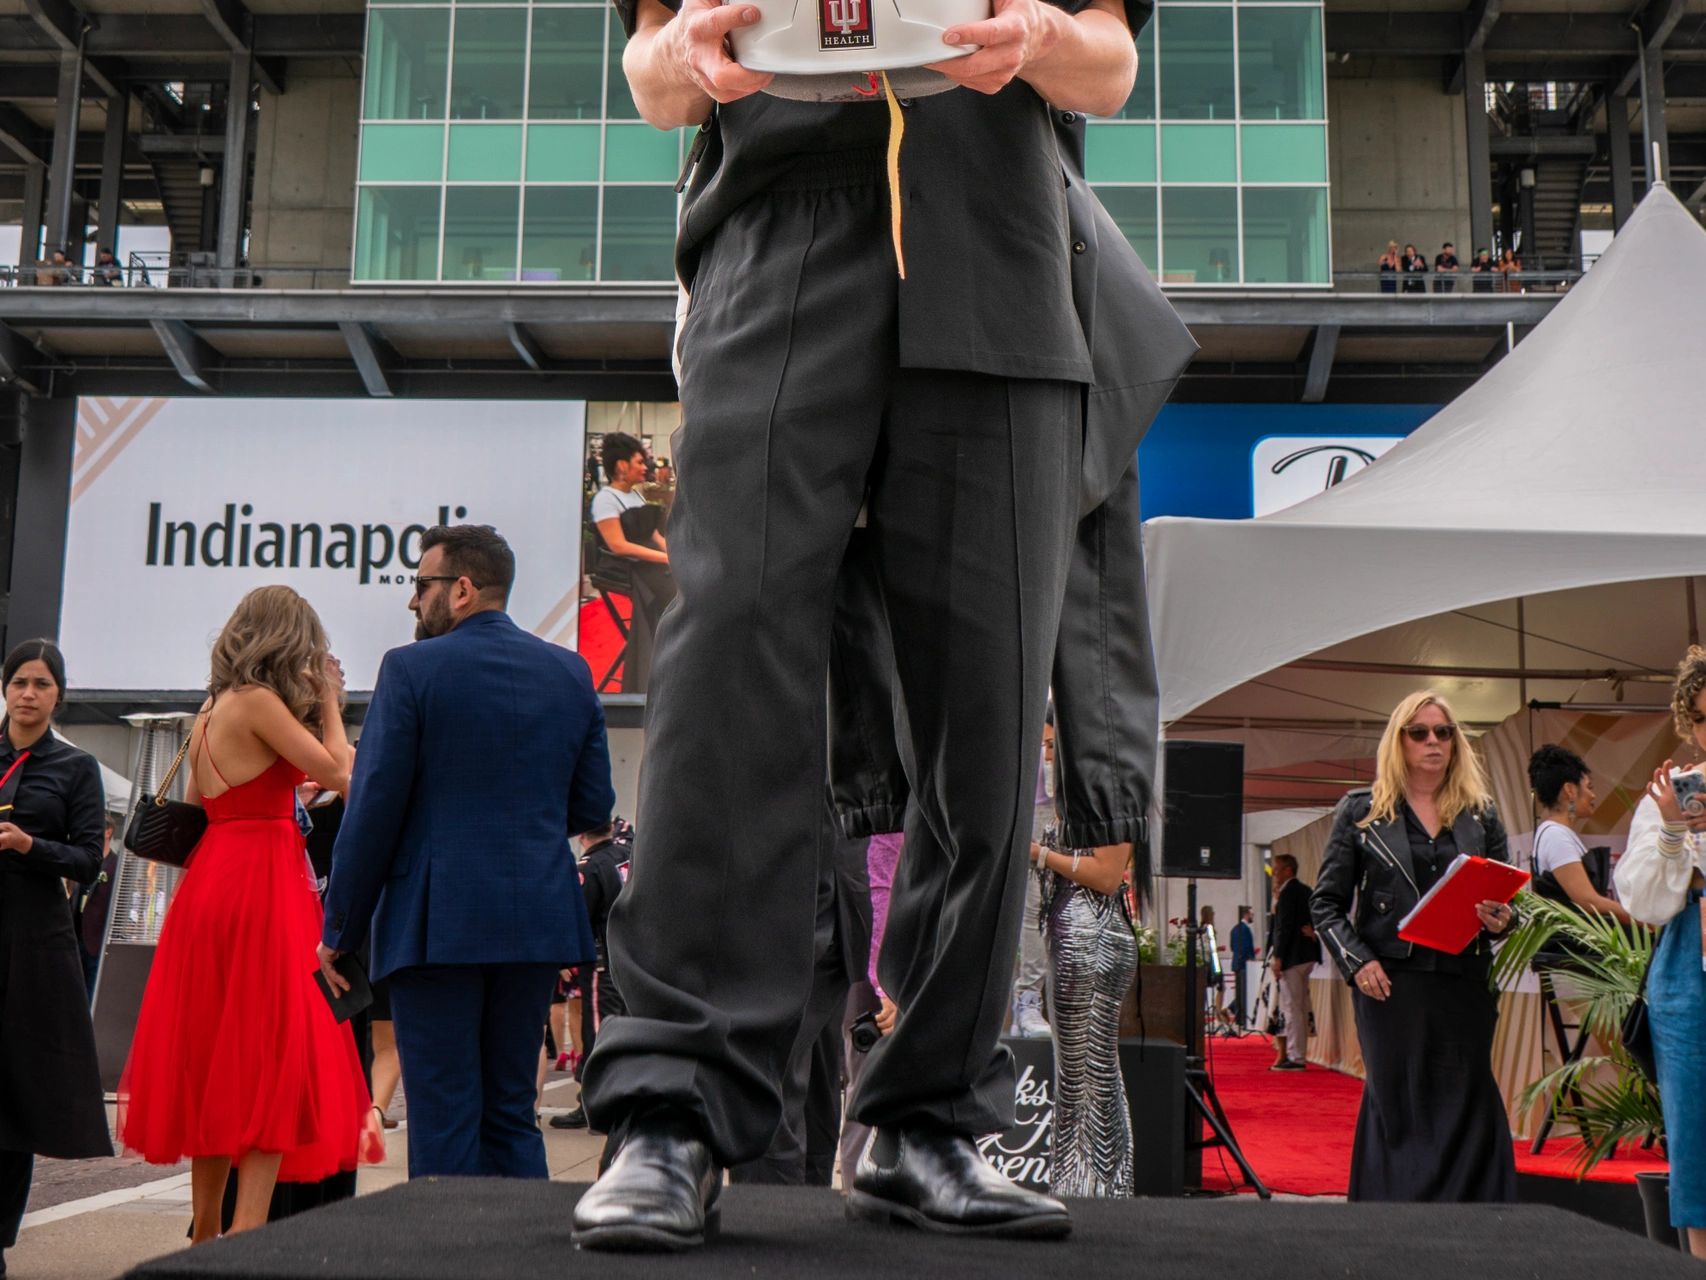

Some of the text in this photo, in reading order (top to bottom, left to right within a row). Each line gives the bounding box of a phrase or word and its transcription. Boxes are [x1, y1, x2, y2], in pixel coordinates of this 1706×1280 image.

[824, 35, 870, 45] HEALTH
[144, 502, 468, 586] Indianapo
[1015, 1065, 1056, 1106] ks
